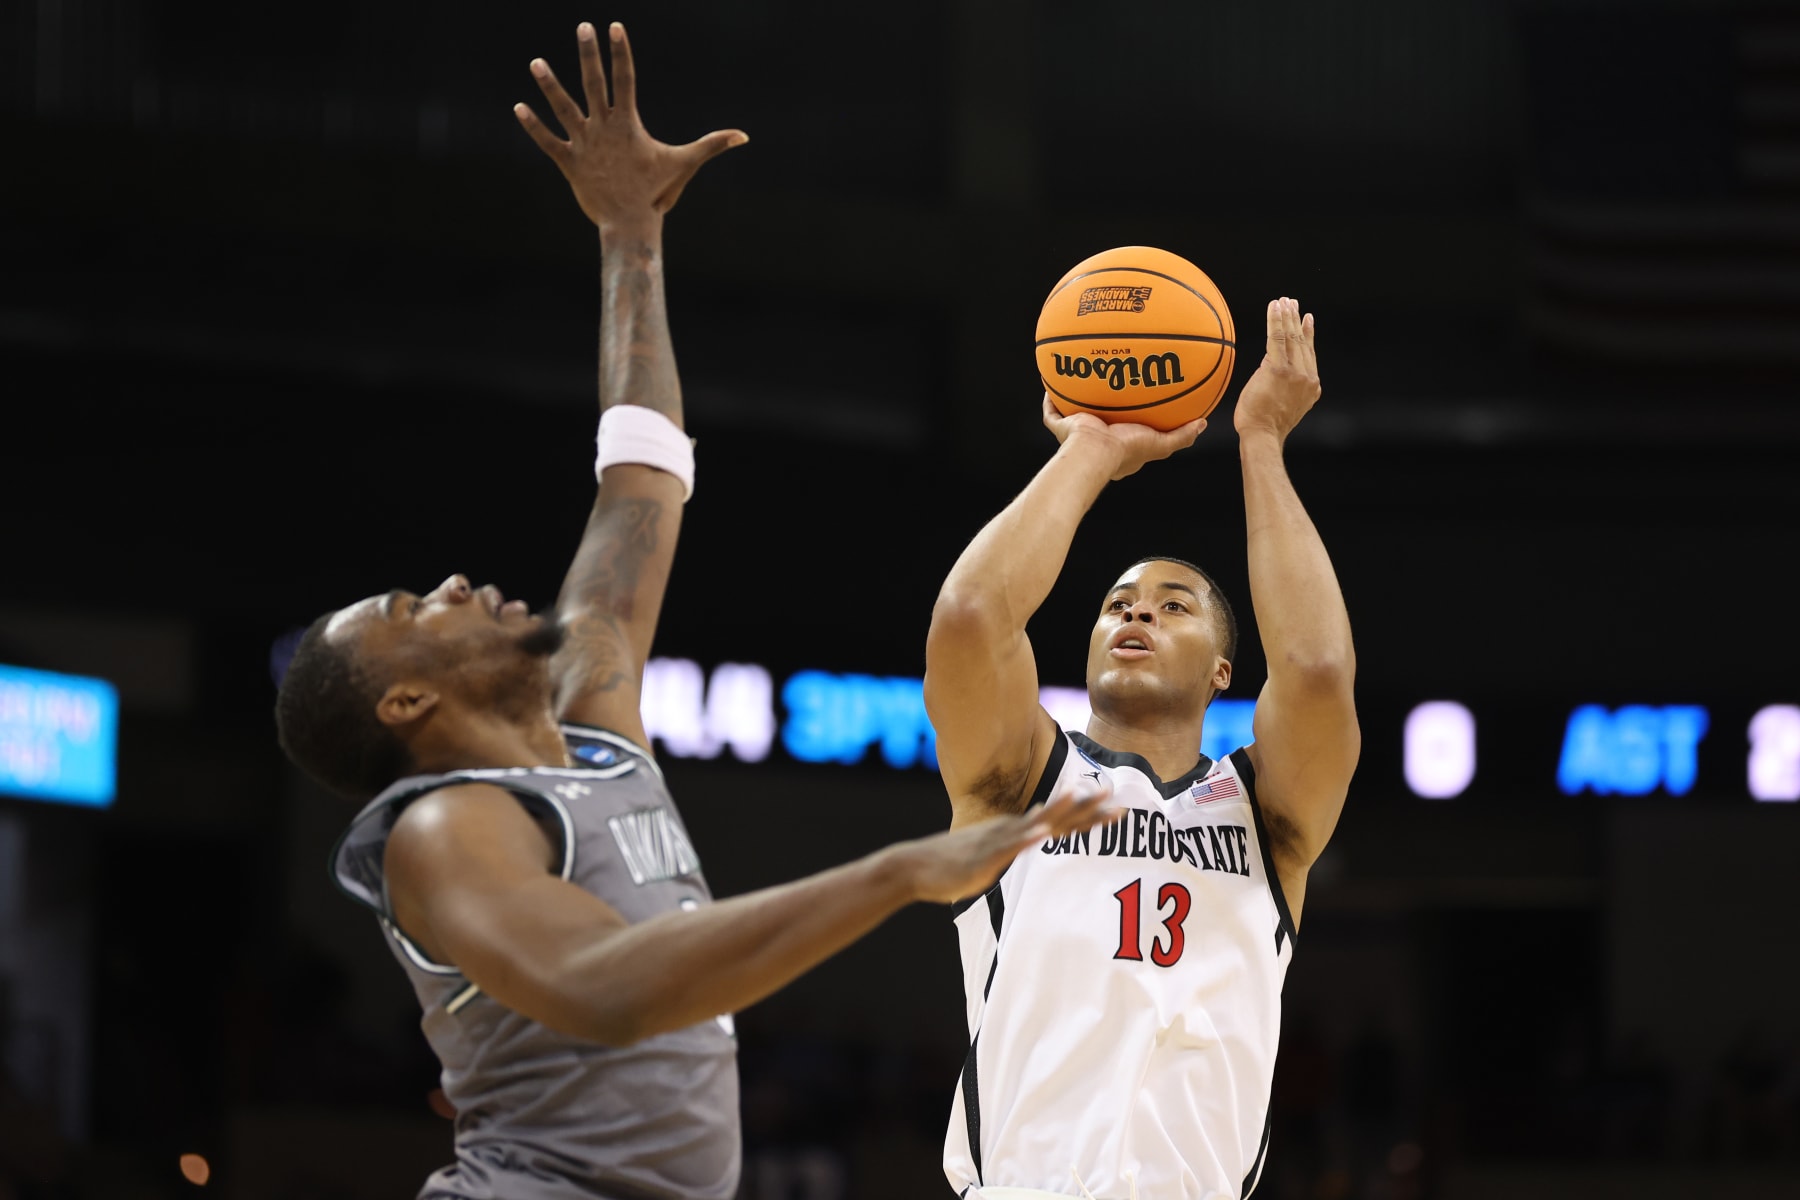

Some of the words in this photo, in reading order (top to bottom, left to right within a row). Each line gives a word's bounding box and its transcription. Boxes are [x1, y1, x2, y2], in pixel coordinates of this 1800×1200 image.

[1080, 290, 1130, 302] MADNESS
[1095, 300, 1133, 311] MARCH
[1054, 352, 1185, 391] Wilson
[1098, 807, 1185, 863] DIEGO
[1176, 825, 1251, 878] STATE
[1113, 878, 1192, 968] 13
